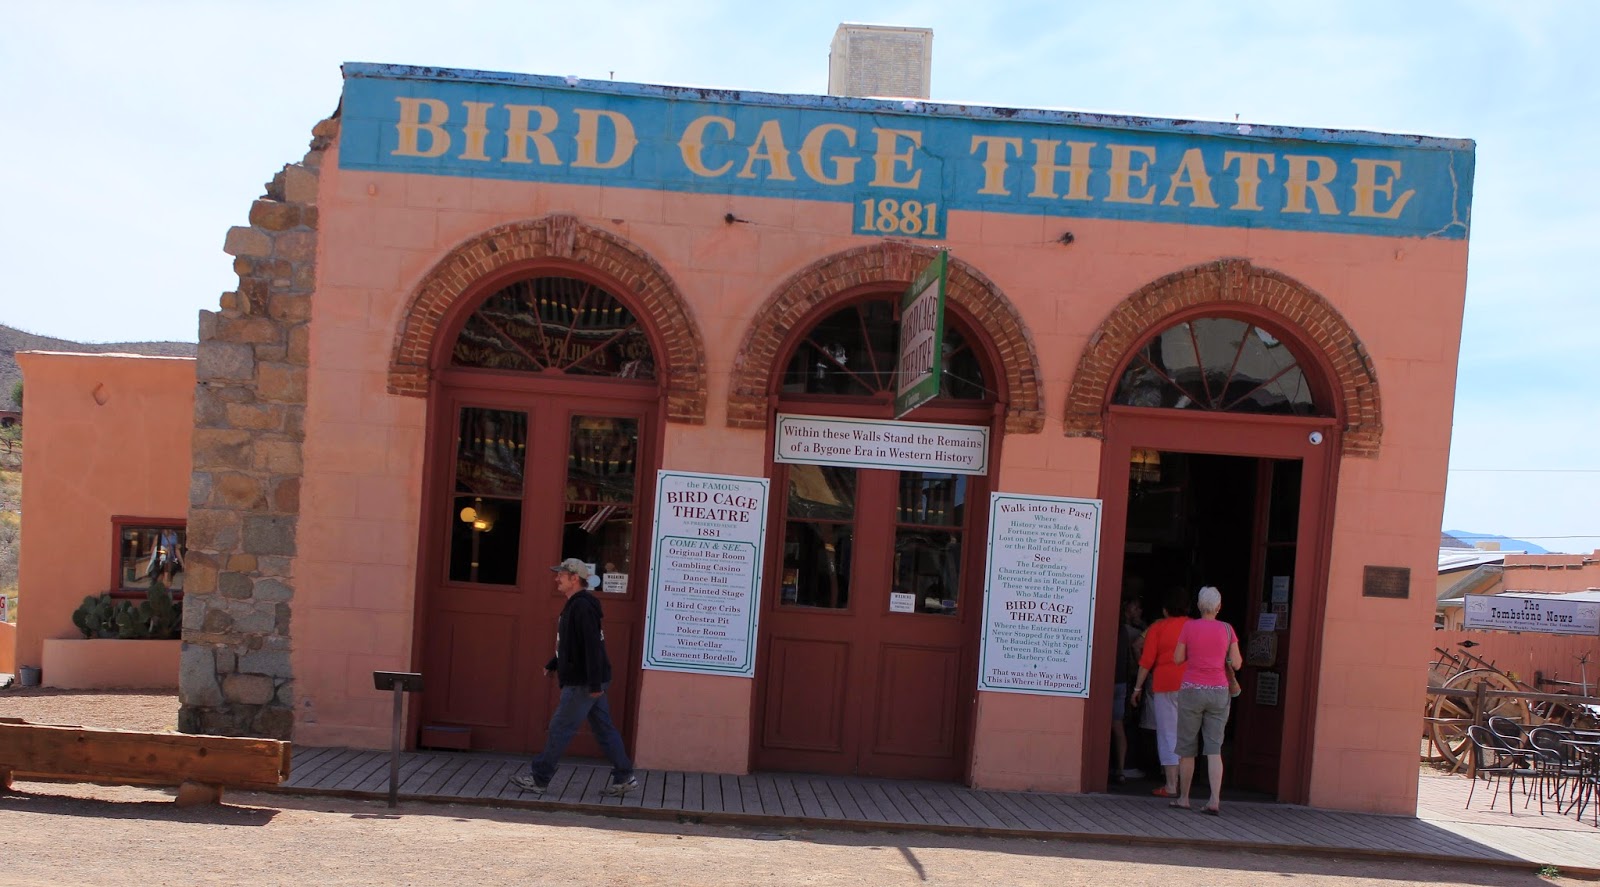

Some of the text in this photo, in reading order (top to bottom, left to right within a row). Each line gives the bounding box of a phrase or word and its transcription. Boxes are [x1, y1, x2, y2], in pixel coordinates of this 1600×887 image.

[391, 96, 1417, 220] BIRD CAGE THEATRE
[861, 198, 940, 236] 1881
[918, 296, 938, 332] CAGE
[902, 336, 933, 388] THEATRE
[784, 425, 981, 448] Within these Walls Stand the Remains
[791, 442, 802, 452] of
[813, 443, 850, 456] Bygone
[854, 446, 872, 457] Era
[876, 447, 886, 457] in
[889, 448, 931, 460] Western
[935, 451, 973, 464] History
[702, 482, 739, 491] FAMOUS
[667, 491, 758, 510] BIRD CAGE
[673, 506, 750, 522] THEATRE
[1001, 504, 1092, 520] Walk into the Past!
[1011, 521, 1036, 529] History
[697, 528, 720, 537] 1881
[1008, 528, 1038, 536] Fortunes
[669, 539, 697, 548] COME
[699, 541, 710, 549] IN
[722, 544, 747, 552] SEE...
[669, 548, 702, 557] Original
[722, 552, 745, 560] Room
[1034, 554, 1051, 562] See
[672, 561, 711, 571] Gambling
[1032, 562, 1068, 570] Legendary
[683, 574, 708, 582] Dance
[710, 576, 727, 584] Hall
[998, 575, 1032, 583] Recreated
[1048, 570, 1085, 579] Tombstone
[664, 585, 685, 593] Hand
[689, 587, 719, 595] Painted
[722, 589, 744, 598] Stage
[1056, 586, 1078, 594] People
[697, 604, 716, 612] Cage
[719, 605, 741, 613] Cribs
[1006, 601, 1074, 614] BIRD CAGE
[1524, 600, 1540, 610] The
[675, 614, 715, 623] Orchestra
[1010, 612, 1067, 624] THEATRE
[1492, 608, 1573, 623] Tombstone News
[676, 626, 700, 634] Poker
[1031, 625, 1081, 634] Entertainment
[1015, 631, 1042, 639] Stopped
[678, 639, 722, 648] WineCellar
[1042, 640, 1061, 648] Night
[661, 650, 700, 659] Basement
[703, 653, 737, 662] Bordello
[1044, 680, 1082, 689] Happened!
